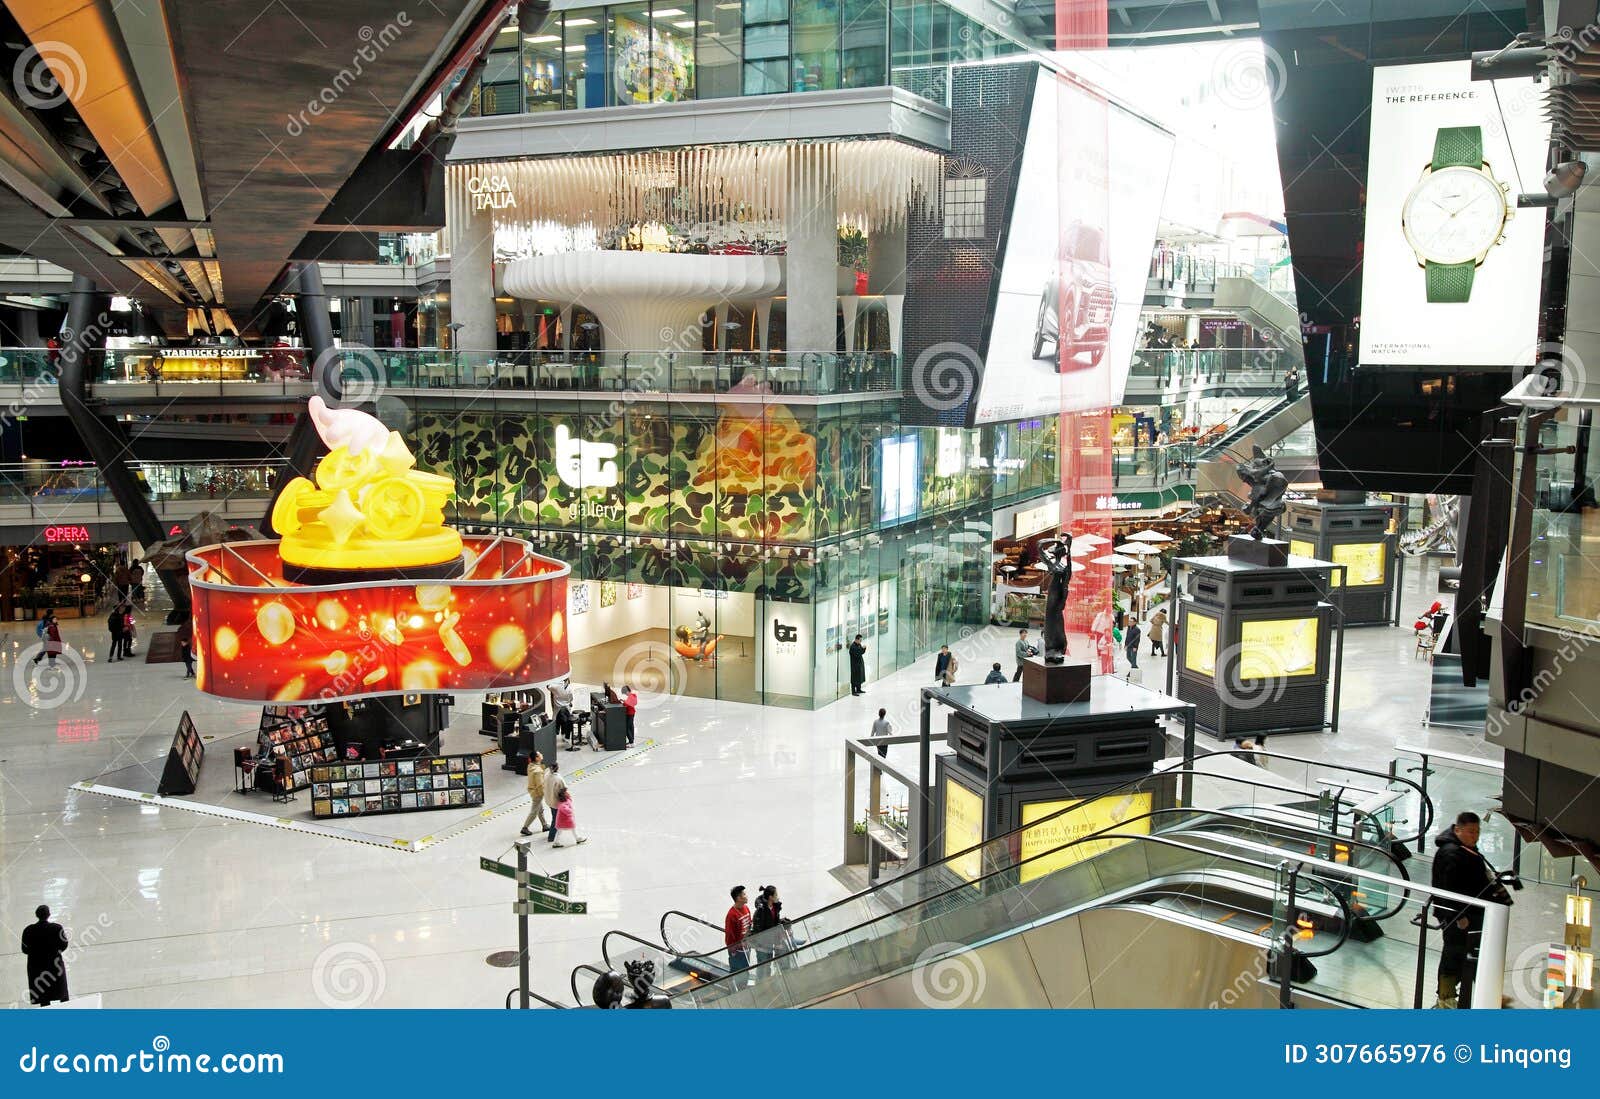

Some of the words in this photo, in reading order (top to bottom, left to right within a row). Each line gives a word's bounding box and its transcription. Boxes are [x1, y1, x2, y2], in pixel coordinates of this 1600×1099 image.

[1386, 96, 1406, 104] THE
[1410, 91, 1479, 102] REFERENCE.
[468, 175, 511, 193] CASA
[473, 191, 517, 210] TALIA
[160, 349, 219, 357] STARBUCKS
[220, 349, 257, 357] COFFEE
[569, 502, 618, 521] gallery
[45, 527, 89, 538] OPERA
